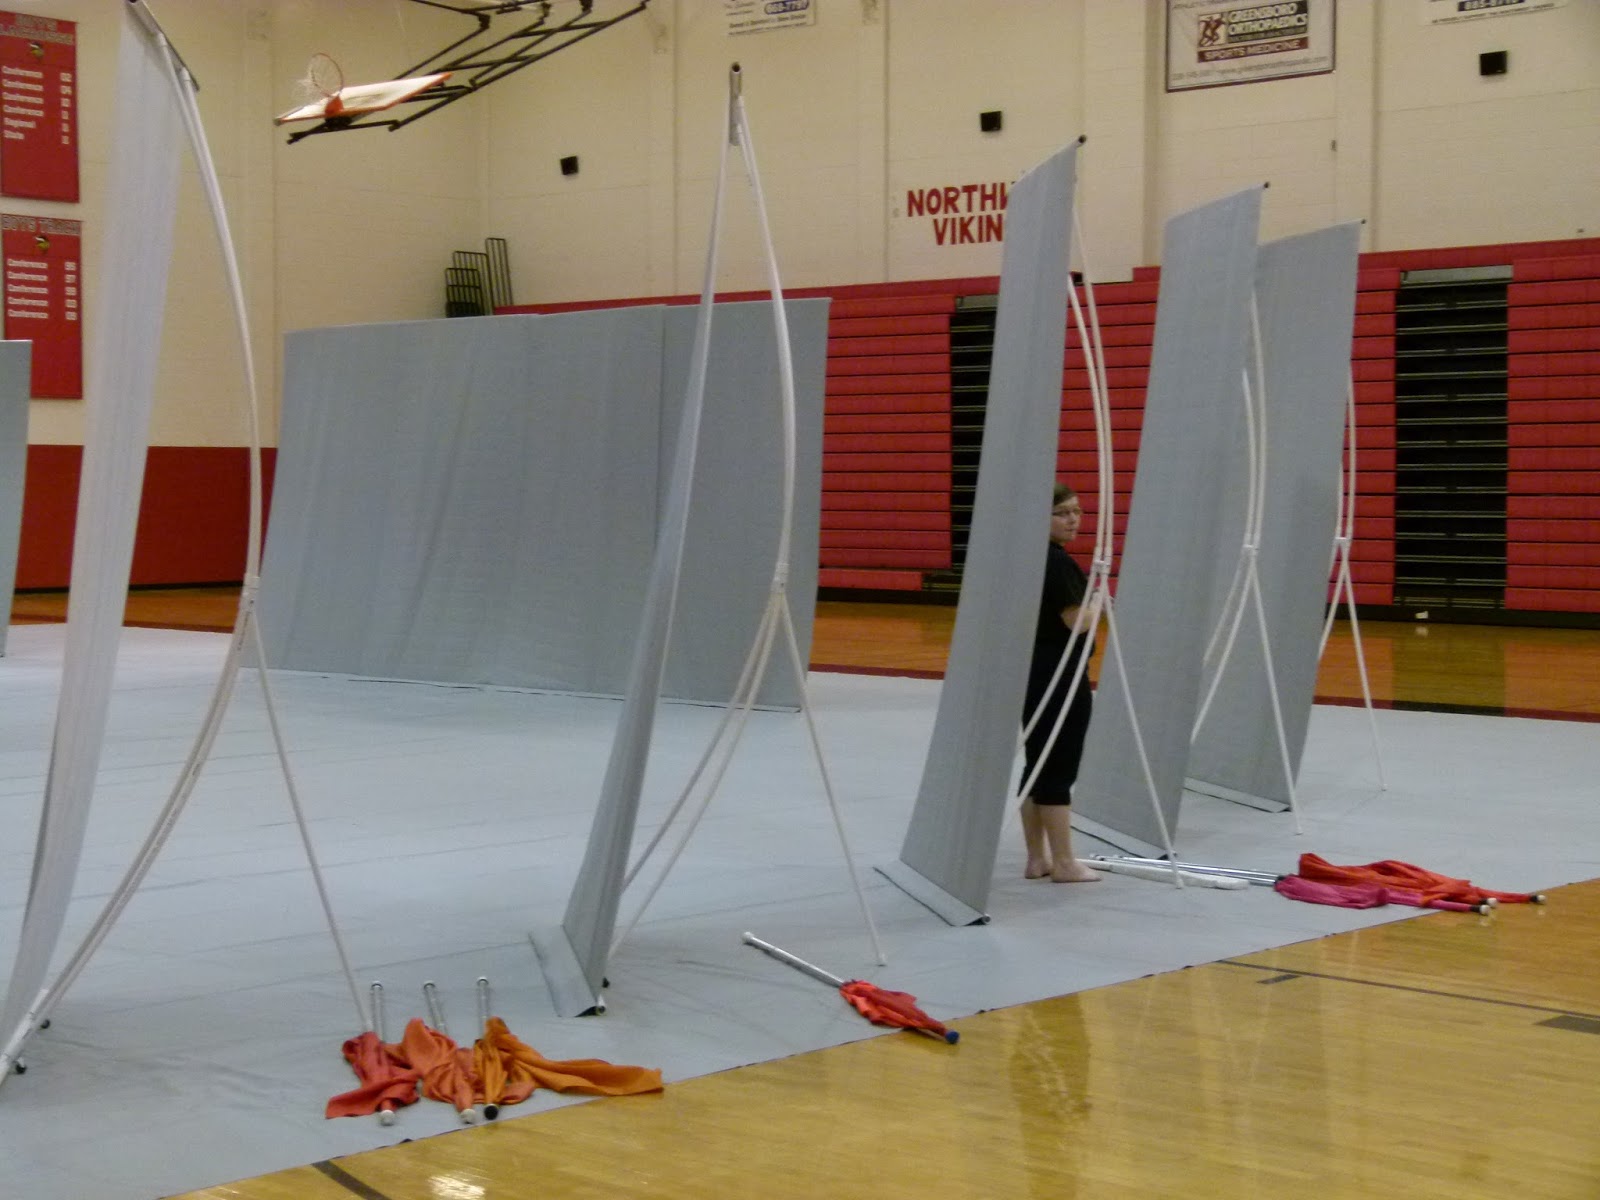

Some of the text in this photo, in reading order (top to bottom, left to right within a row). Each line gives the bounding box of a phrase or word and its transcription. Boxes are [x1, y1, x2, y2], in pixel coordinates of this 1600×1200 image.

[1229, 3, 1298, 23] GREENSBORO
[1229, 13, 1308, 35] ORTHOPAEDICS
[1204, 40, 1300, 60] SPORTS MEDICINE
[933, 213, 1003, 246] VIKIN
